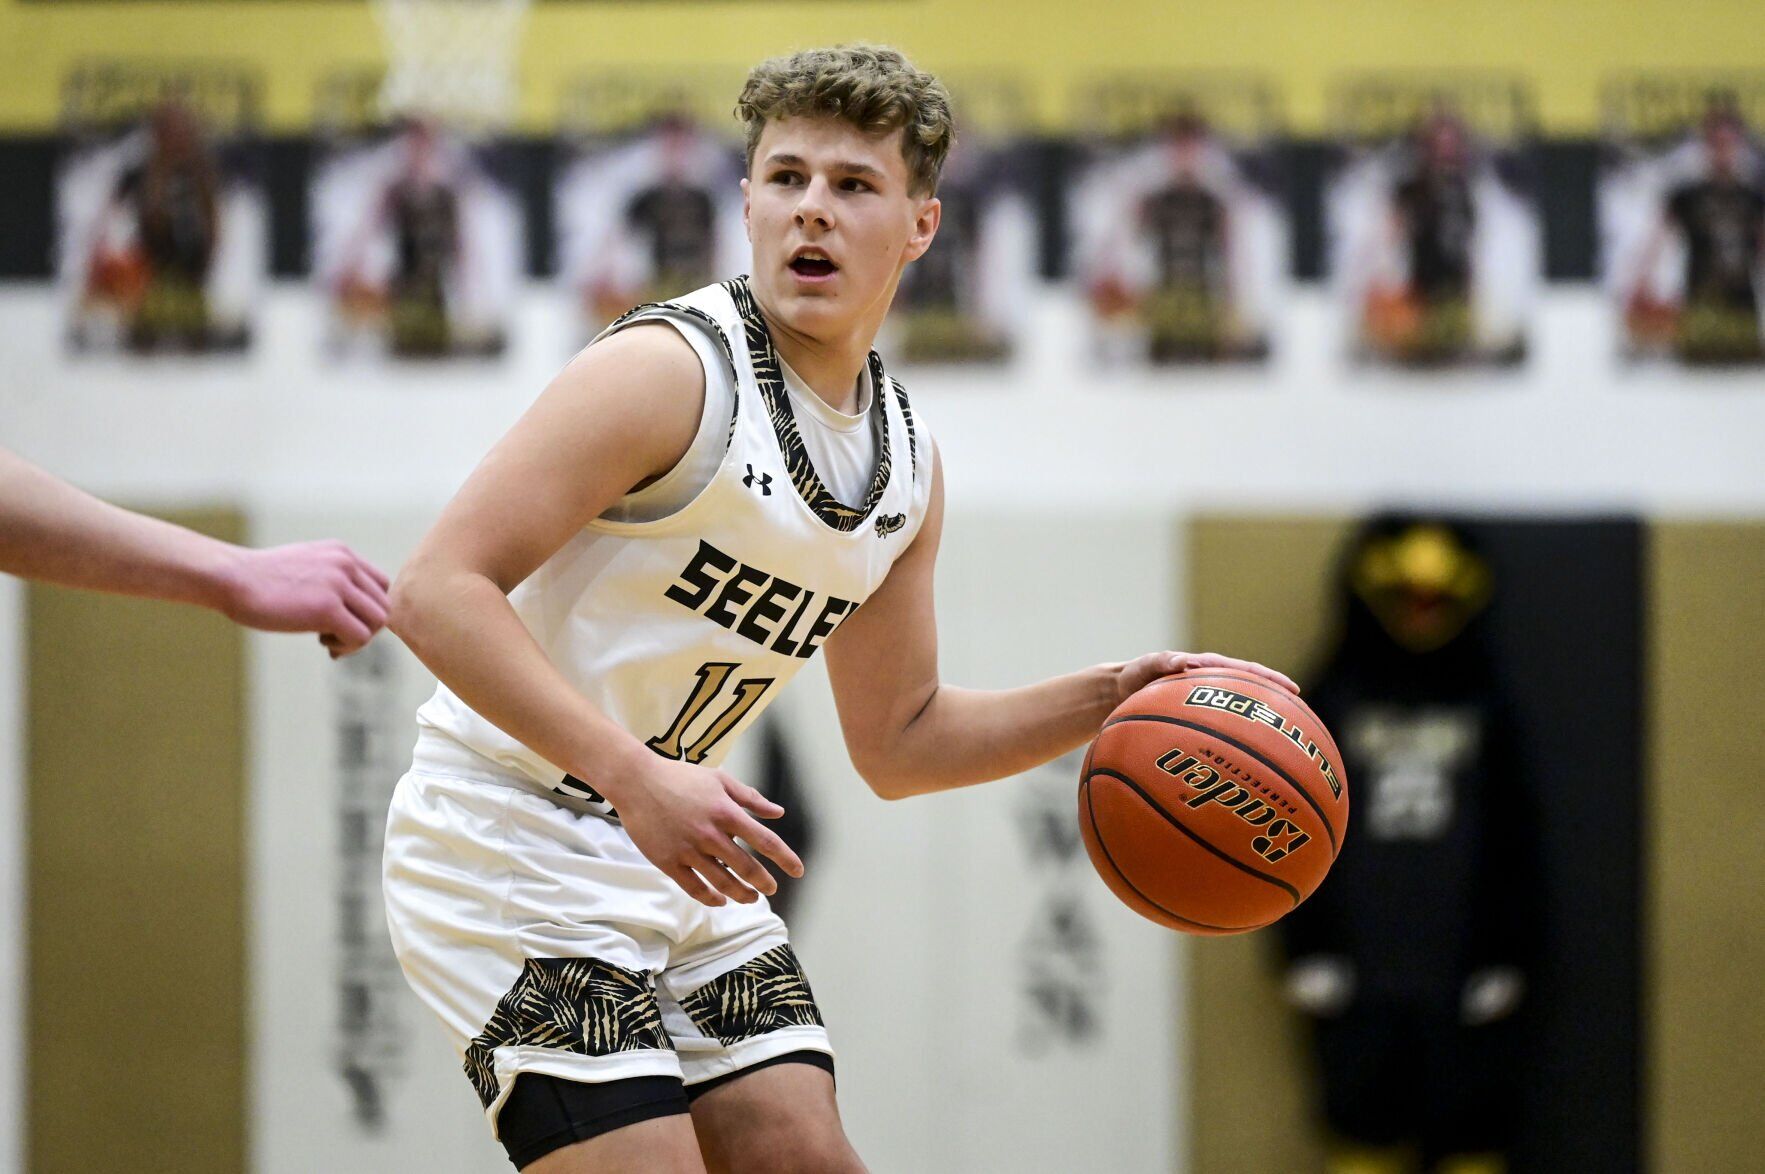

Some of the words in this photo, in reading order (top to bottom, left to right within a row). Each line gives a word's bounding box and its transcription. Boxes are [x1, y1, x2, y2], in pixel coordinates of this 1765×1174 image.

[663, 538, 860, 659] SEELE
[645, 661, 776, 765] 11
[1184, 686, 1253, 721] PRO
[1155, 748, 1312, 864] Baden
[1200, 749, 1298, 815] PERFECTION
